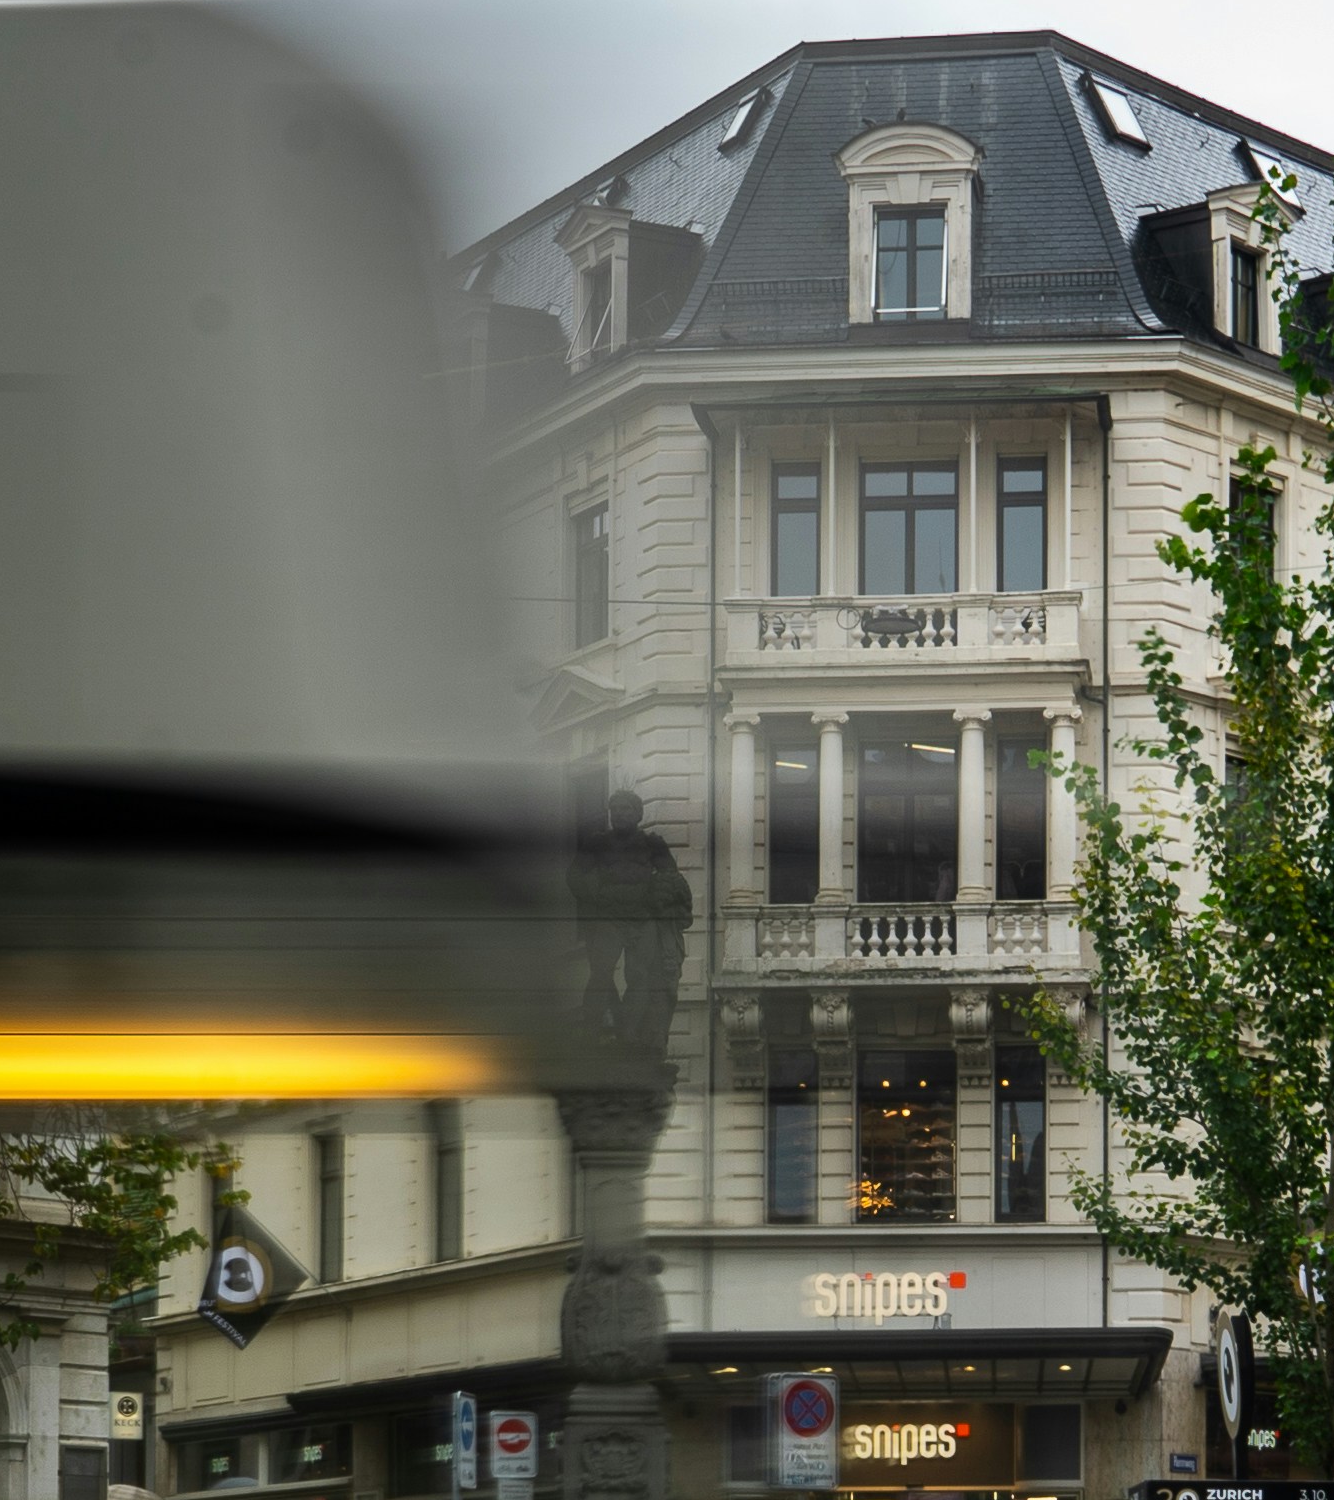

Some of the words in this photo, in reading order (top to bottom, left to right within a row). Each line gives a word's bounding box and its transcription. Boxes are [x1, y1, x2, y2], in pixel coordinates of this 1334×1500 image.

[815, 1271, 949, 1326] snipes
[114, 1419, 141, 1427] KECK
[855, 1423, 956, 1465] snipes
[1207, 1489, 1263, 1500] ZURICH
